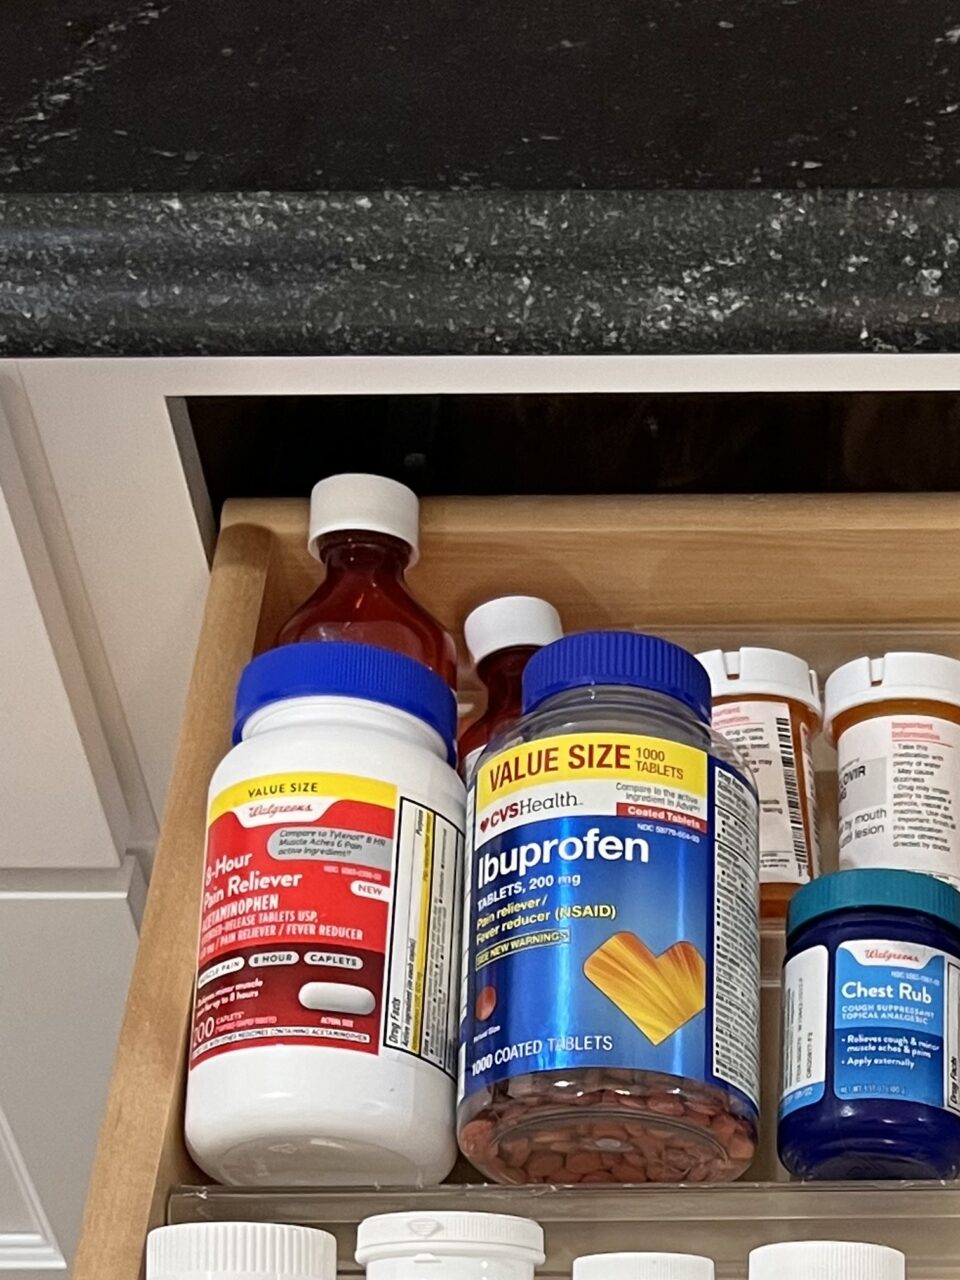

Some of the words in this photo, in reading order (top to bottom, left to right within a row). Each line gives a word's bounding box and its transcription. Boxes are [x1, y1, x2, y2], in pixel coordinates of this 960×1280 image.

[636, 748, 665, 761] 1000
[489, 748, 559, 792] VALUE
[568, 744, 631, 770] SIZE
[635, 761, 683, 780] TABLETS
[248, 784, 285, 797] VALUE
[290, 783, 318, 792] SIZE
[628, 806, 664, 819] Coated
[667, 810, 700, 829] Tablets
[854, 809, 887, 823] mouth
[855, 823, 884, 838] lesion
[478, 828, 648, 889] Ibuprofen
[204, 890, 224, 912] Pain
[228, 871, 302, 897] Reliever
[358, 884, 382, 895] NEW
[477, 882, 526, 911] TABLETS,
[530, 875, 554, 890] 200
[558, 874, 581, 886] mg
[476, 926, 500, 944] Fever
[502, 911, 550, 935] reducer
[555, 905, 616, 920] (NSAID)
[310, 955, 357, 966] CAPLETS
[842, 982, 893, 998] Chest
[899, 984, 932, 1004] Rub
[877, 1005, 934, 1018] SUPPRESSANT
[472, 1053, 493, 1075] 1000
[495, 1041, 543, 1065] COATED
[547, 1036, 613, 1053] TABLETS
